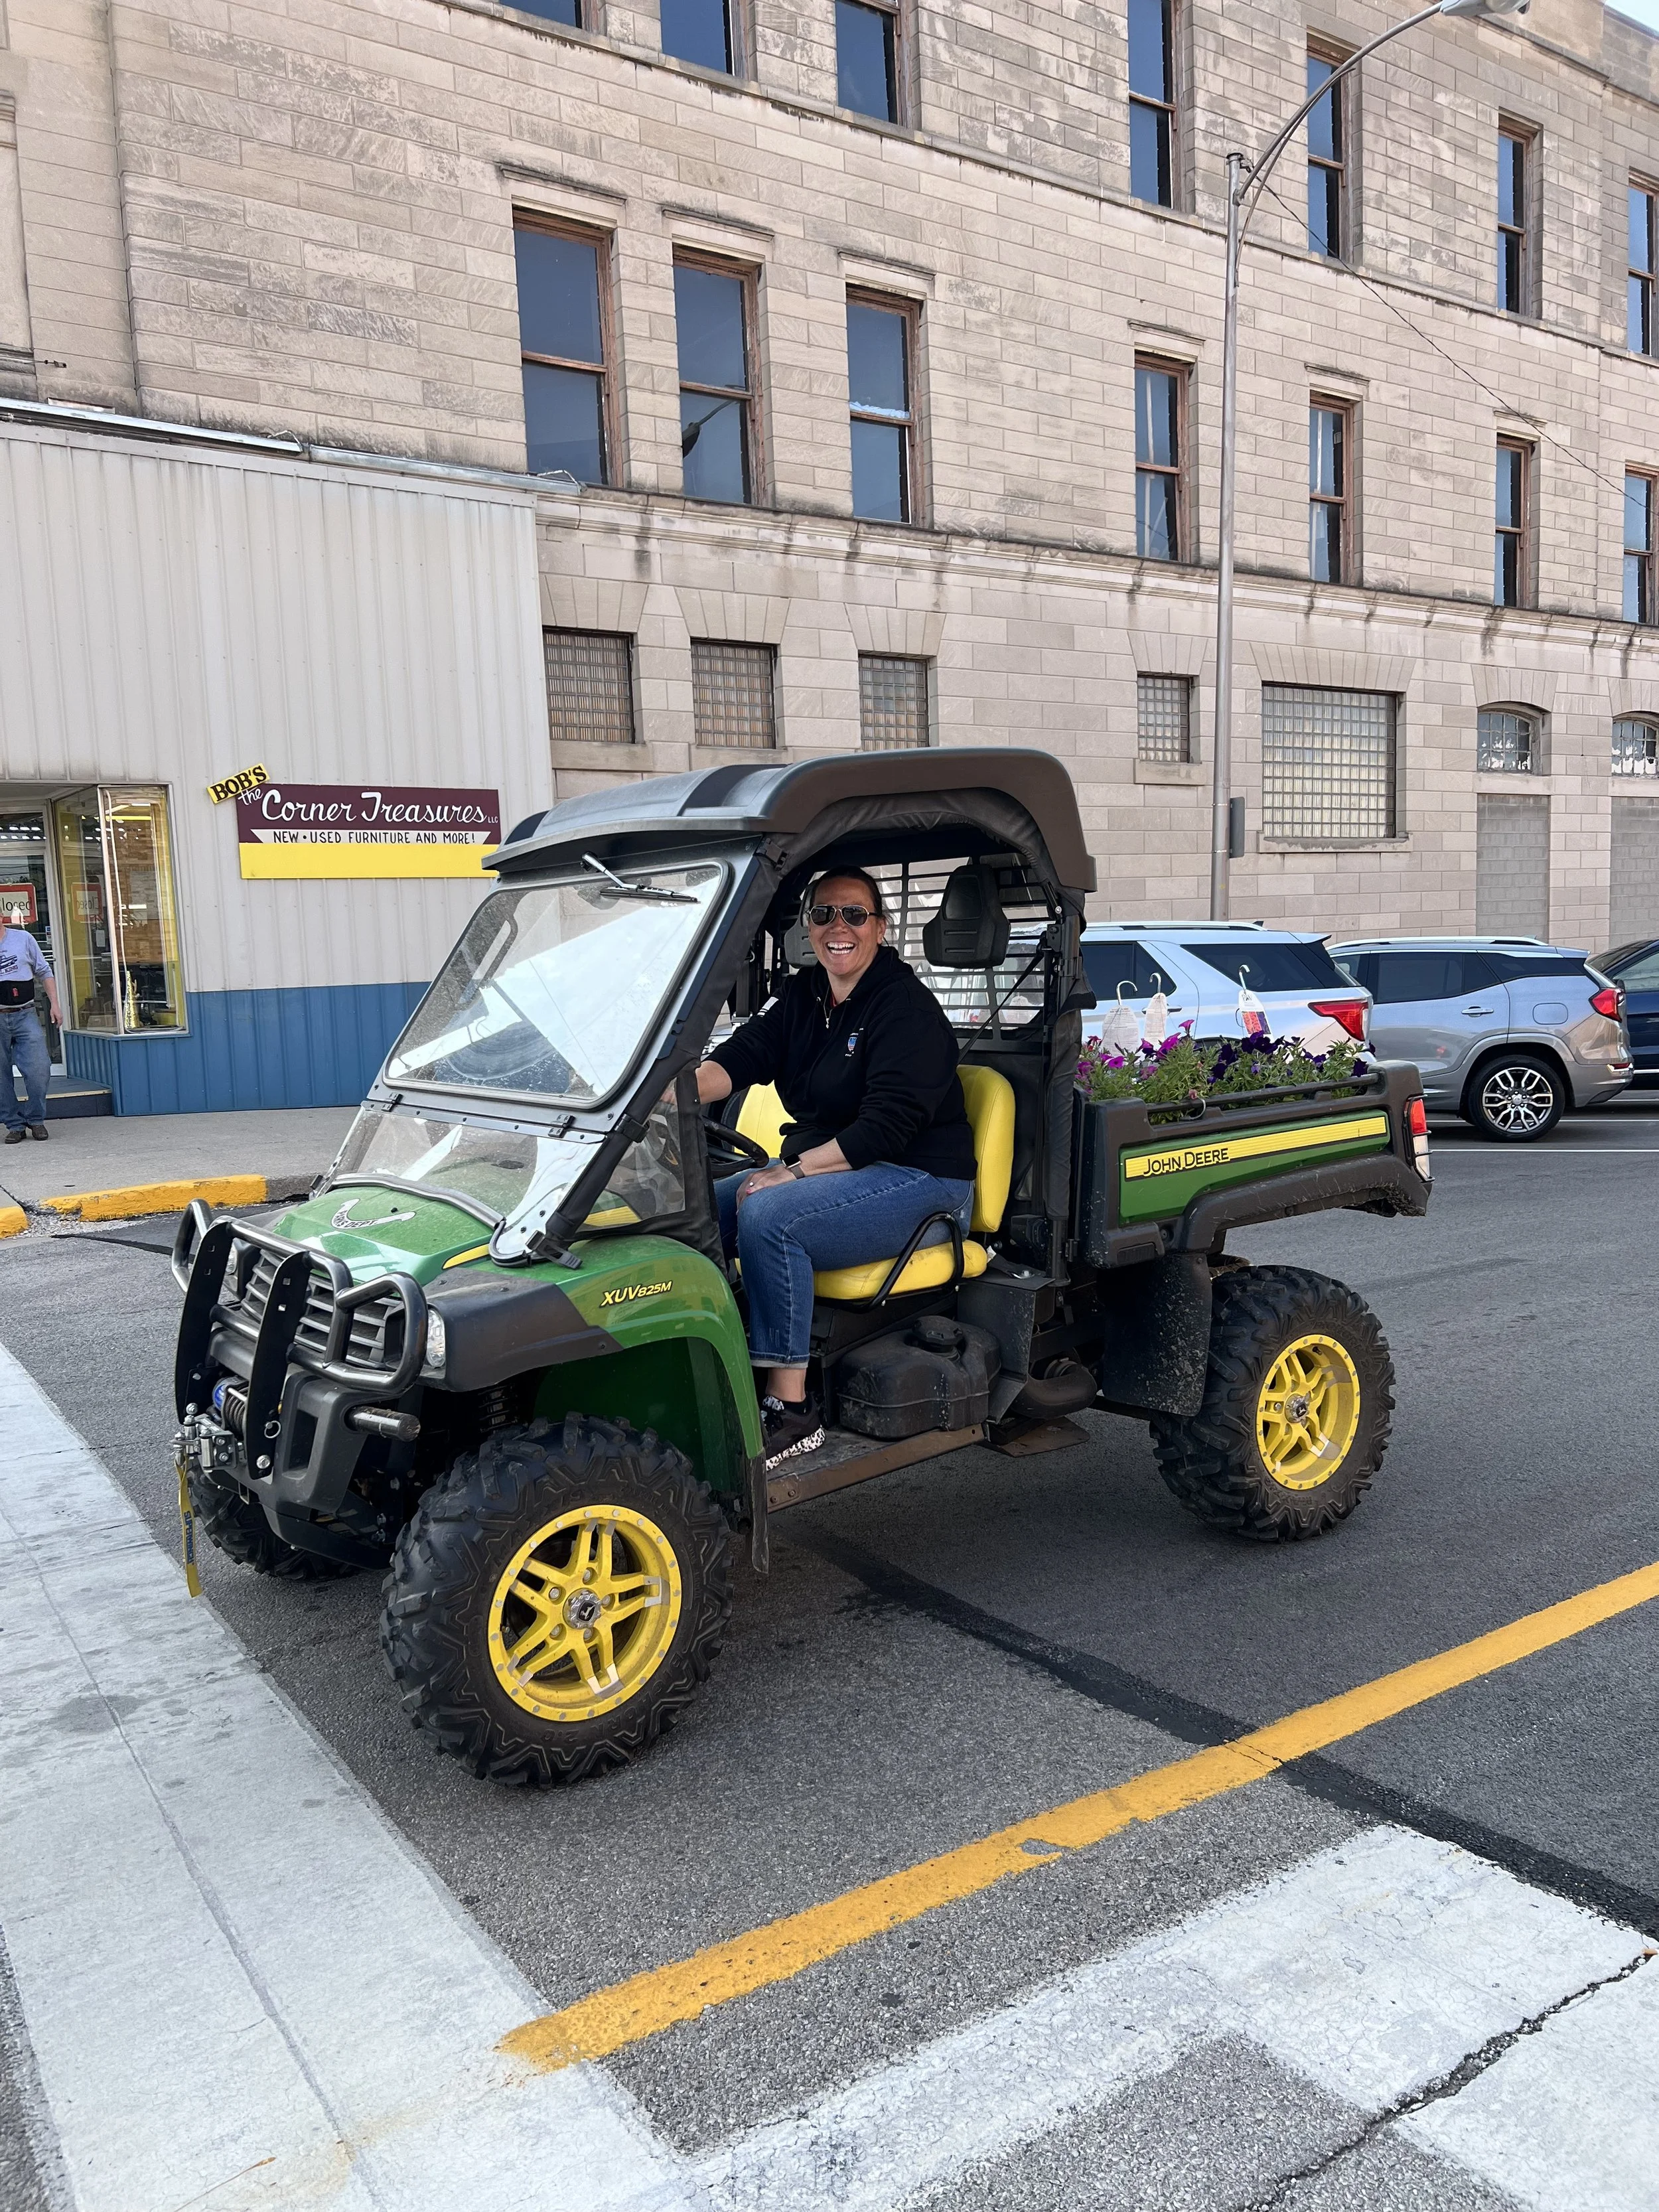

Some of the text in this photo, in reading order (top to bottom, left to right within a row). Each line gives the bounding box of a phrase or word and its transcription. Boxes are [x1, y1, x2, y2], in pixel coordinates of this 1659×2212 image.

[211, 765, 267, 802] BOB'S
[238, 787, 263, 806] the
[261, 789, 357, 822] Corner
[360, 792, 487, 824] Treasures
[273, 832, 476, 844] NEW USED FURNITURE AND MORE!
[0, 897, 33, 911] losed
[1143, 1147, 1230, 1175] JOHN DEERE
[333, 1210, 349, 1227] PARKS
[601, 1281, 672, 1307] XUV825M
